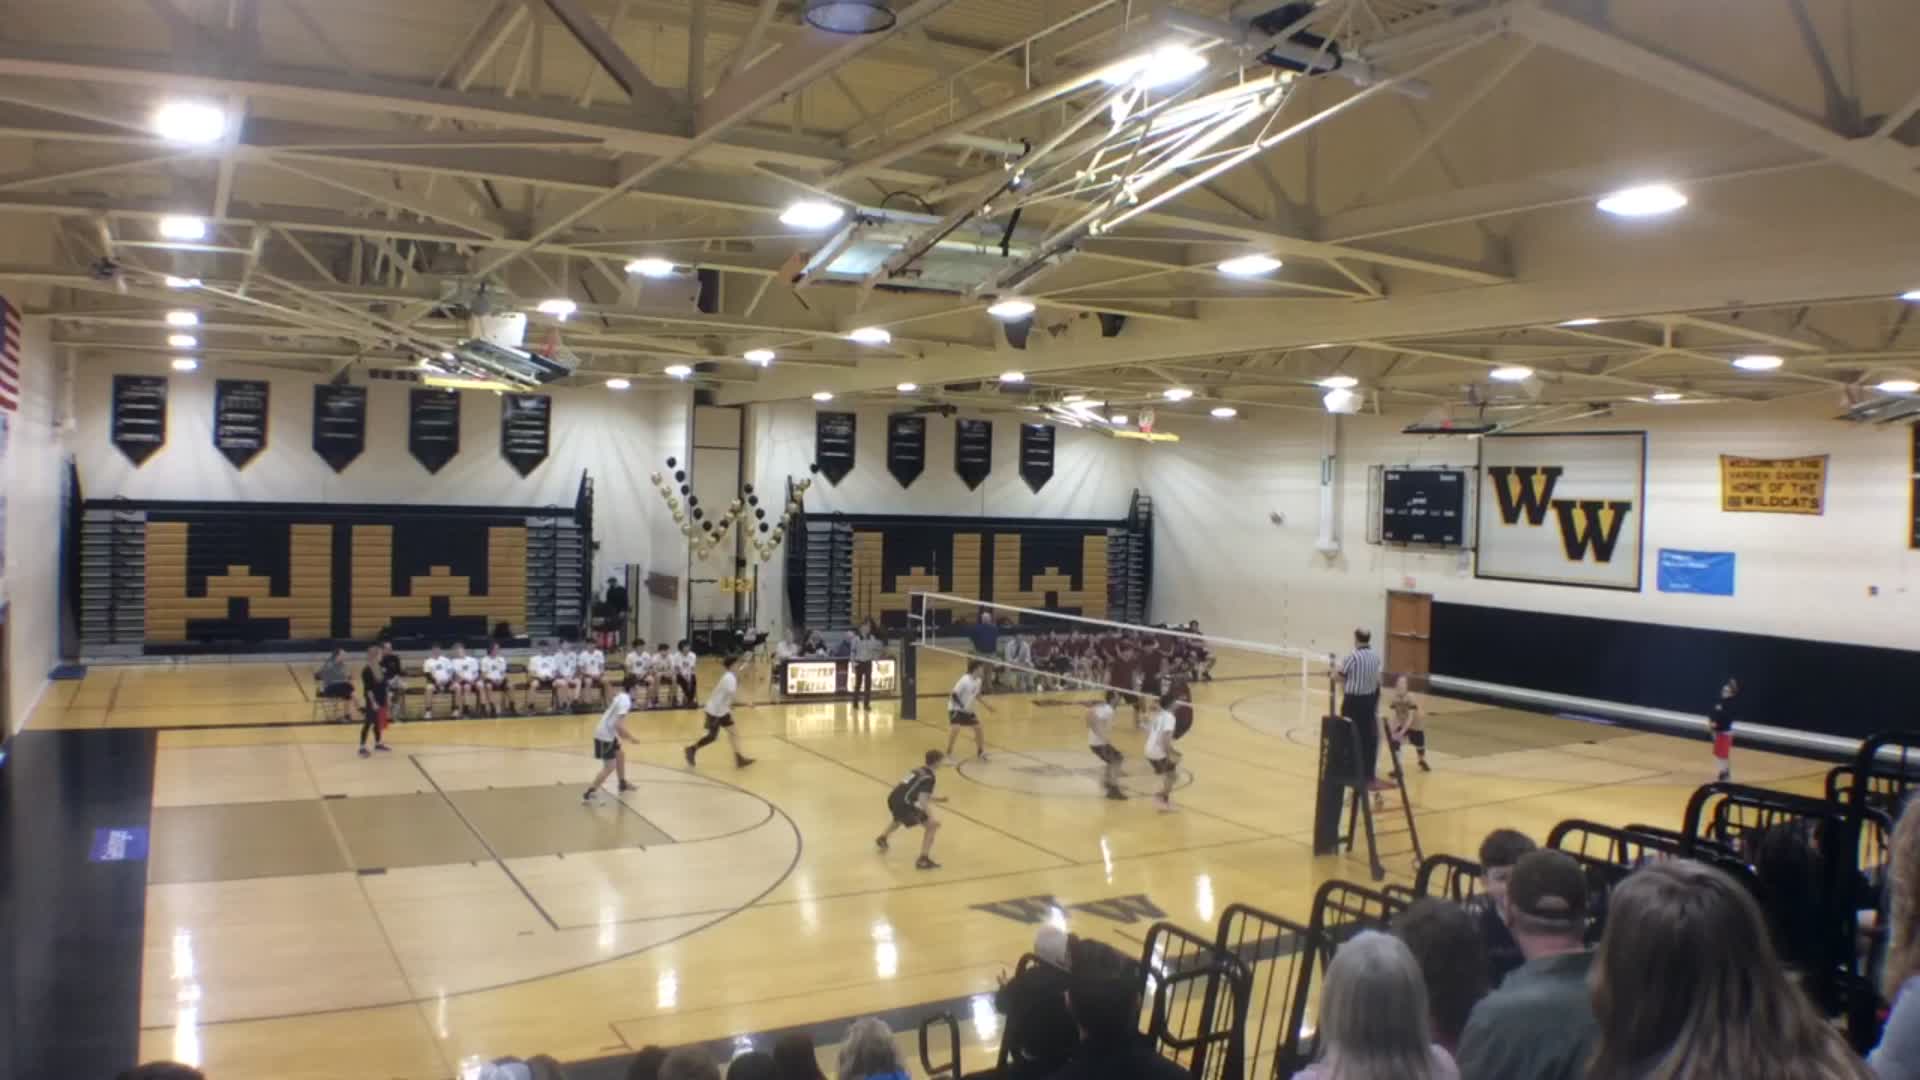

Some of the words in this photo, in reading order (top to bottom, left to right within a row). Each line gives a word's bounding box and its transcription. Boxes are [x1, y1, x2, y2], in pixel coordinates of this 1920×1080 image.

[1731, 483, 1762, 494] HOME
[1768, 482, 1786, 494] OF
[1791, 483, 1816, 495] THE
[1744, 495, 1819, 509] WILDCATS
